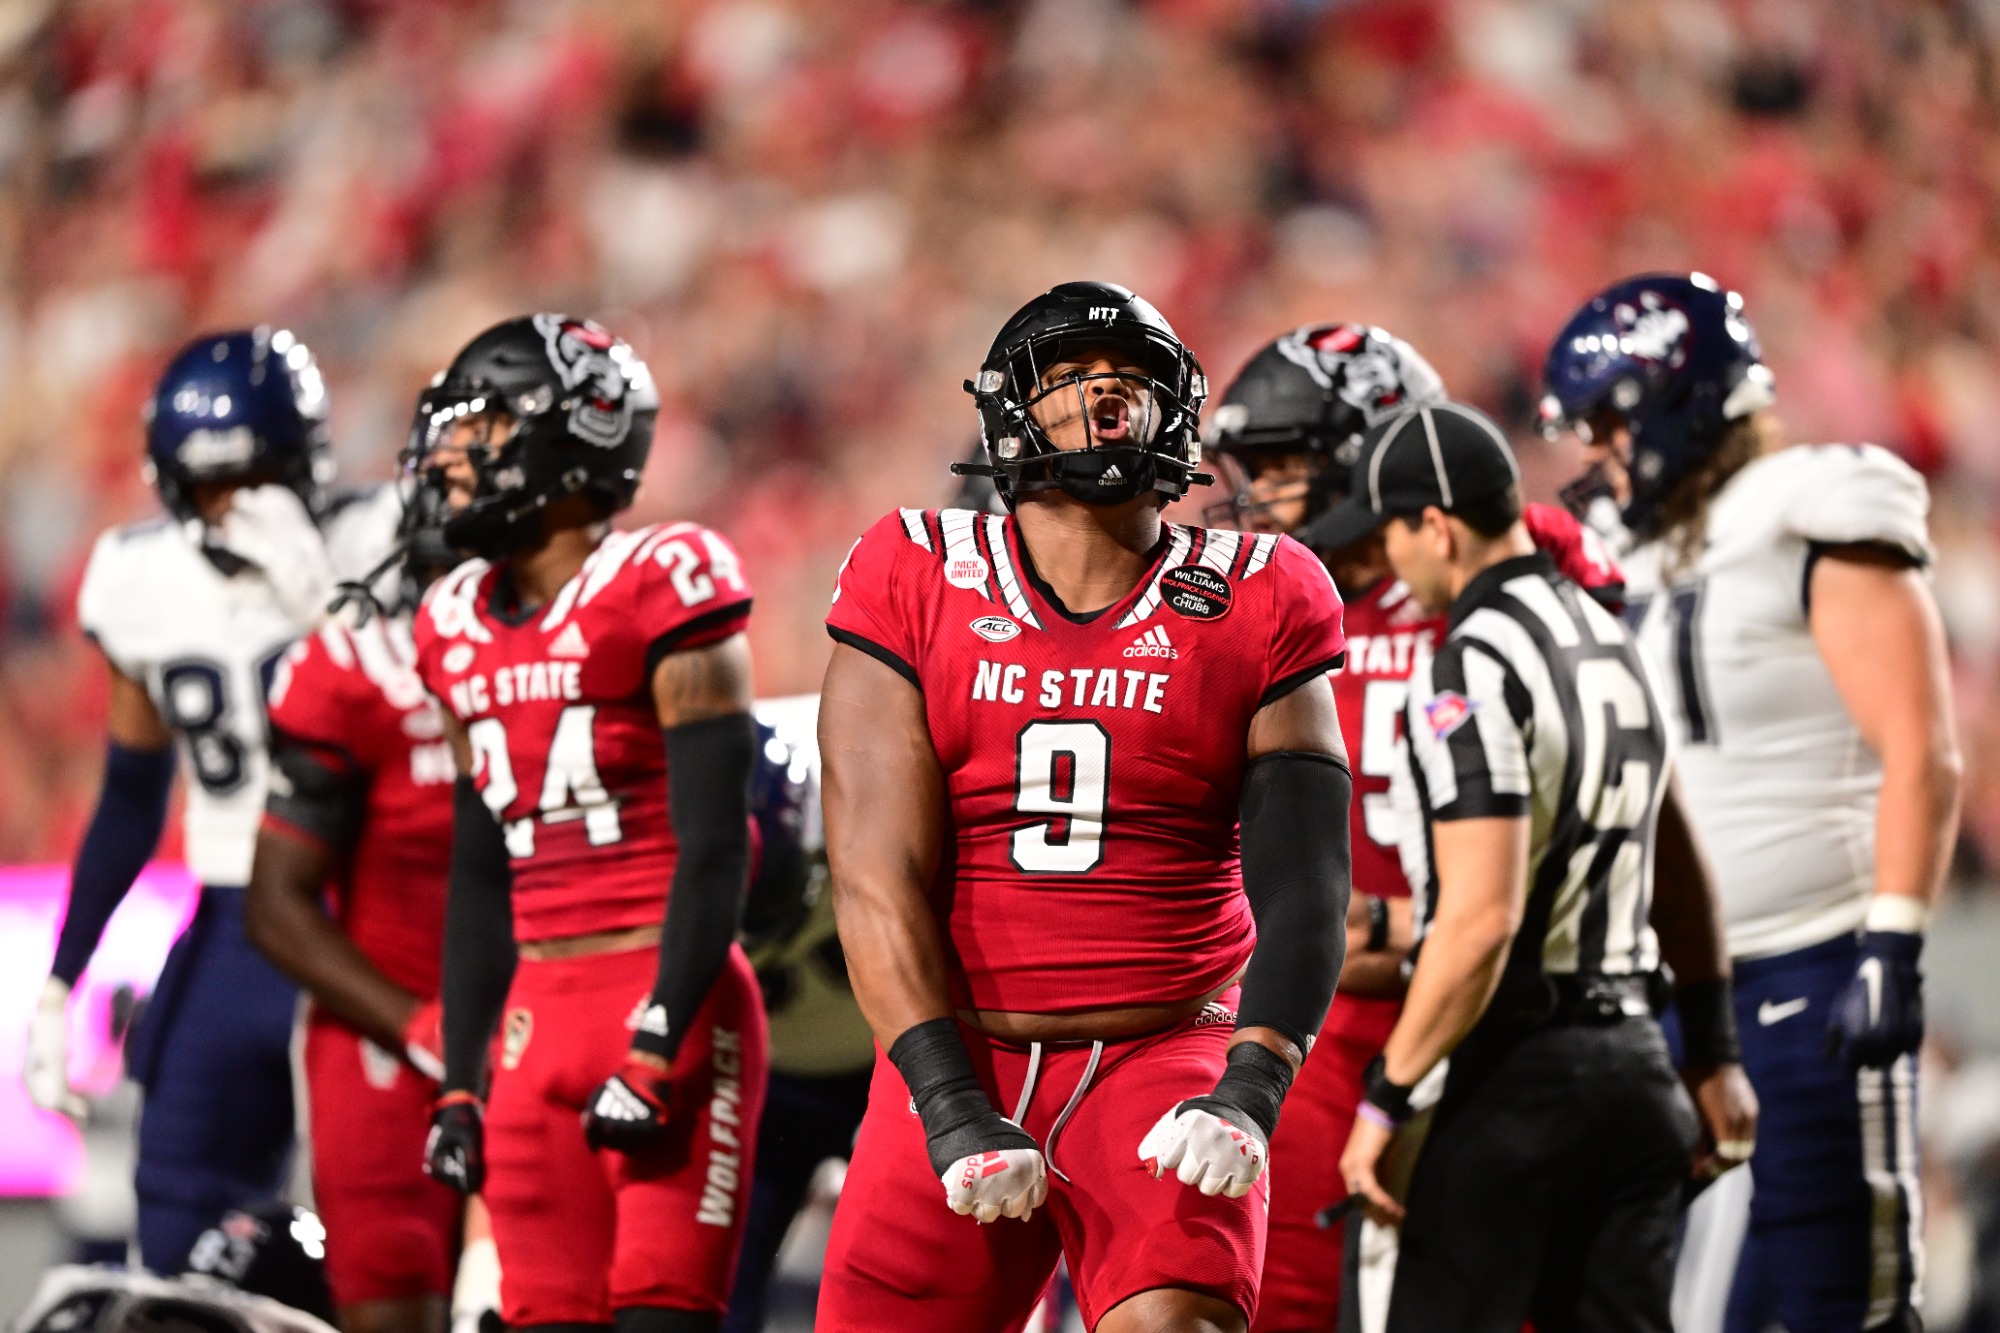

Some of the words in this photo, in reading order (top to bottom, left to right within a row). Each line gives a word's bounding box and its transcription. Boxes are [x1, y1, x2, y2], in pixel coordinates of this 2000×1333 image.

[1088, 306, 1120, 321] HTT
[950, 568, 984, 580] UNITED
[953, 560, 979, 570] PACK
[1174, 570, 1226, 594] WILLIAMS
[1161, 577, 1200, 595] WOLFPACK
[1199, 588, 1231, 607] LEGENDS
[1172, 596, 1210, 615] CHUBB
[979, 622, 1011, 634] ACC
[1122, 643, 1179, 660] adidas
[450, 673, 490, 720] NC
[494, 660, 583, 707] STATE
[972, 659, 1027, 705] NC
[1038, 667, 1171, 715] STATE
[1008, 718, 1112, 875] 9
[1194, 1011, 1238, 1027] adidas
[695, 1025, 741, 1229] WOLFPACK
